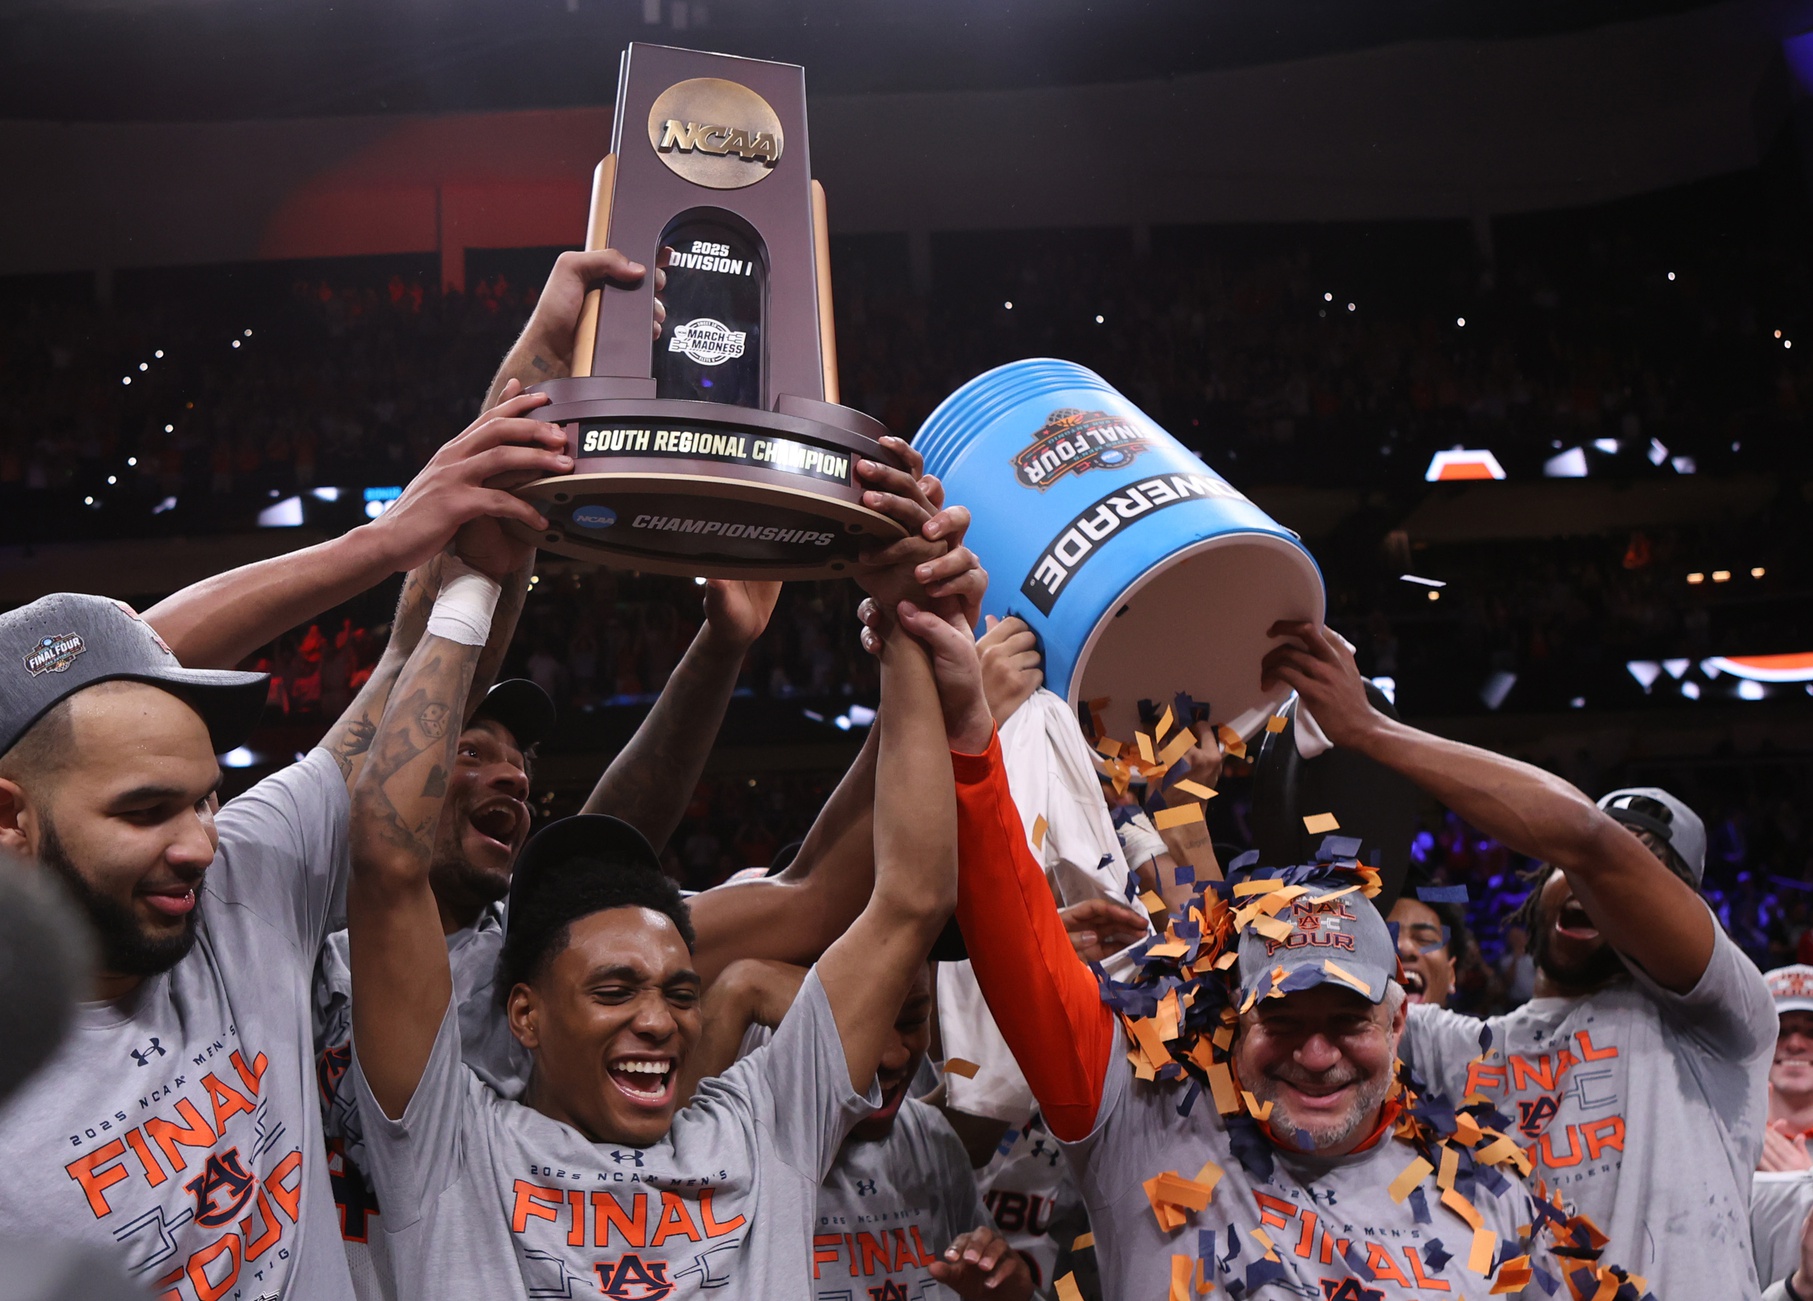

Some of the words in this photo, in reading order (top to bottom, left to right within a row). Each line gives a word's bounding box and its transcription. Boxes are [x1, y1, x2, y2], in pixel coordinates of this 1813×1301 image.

[658, 119, 781, 168] NCAA
[669, 251, 743, 276] DIVISION
[745, 261, 753, 276] I
[691, 240, 730, 257] 2025
[687, 329, 726, 342] MARCH
[691, 340, 743, 354] MADNESS
[1087, 423, 1144, 445] INAL
[583, 429, 650, 453] SOUTH
[653, 431, 747, 459] REGIONAL
[753, 440, 848, 479] CHAMPION
[1023, 432, 1091, 484] FOUR
[576, 514, 615, 525] NCAA
[632, 514, 835, 546] CHAMPIONSHIPS
[1034, 474, 1243, 595] OWERADE
[29, 649, 56, 669] FINAL
[55, 637, 81, 655] FOUR
[1291, 901, 1357, 921] NAL
[1463, 1030, 1619, 1096] FNAL
[69, 1110, 127, 1146] 2025
[139, 1078, 183, 1109] NCAA
[192, 1024, 236, 1066] MEN'S
[64, 1049, 269, 1219] FINAL
[1527, 1115, 1626, 1171] UR
[531, 1165, 581, 1181] 2025
[598, 1172, 654, 1183] NCAA
[671, 1169, 728, 1187] MEN'S
[512, 1178, 747, 1248] FINAL
[1364, 1227, 1420, 1239] MEN'S
[254, 1248, 290, 1281] TIG
[813, 1225, 936, 1279] FINAL
